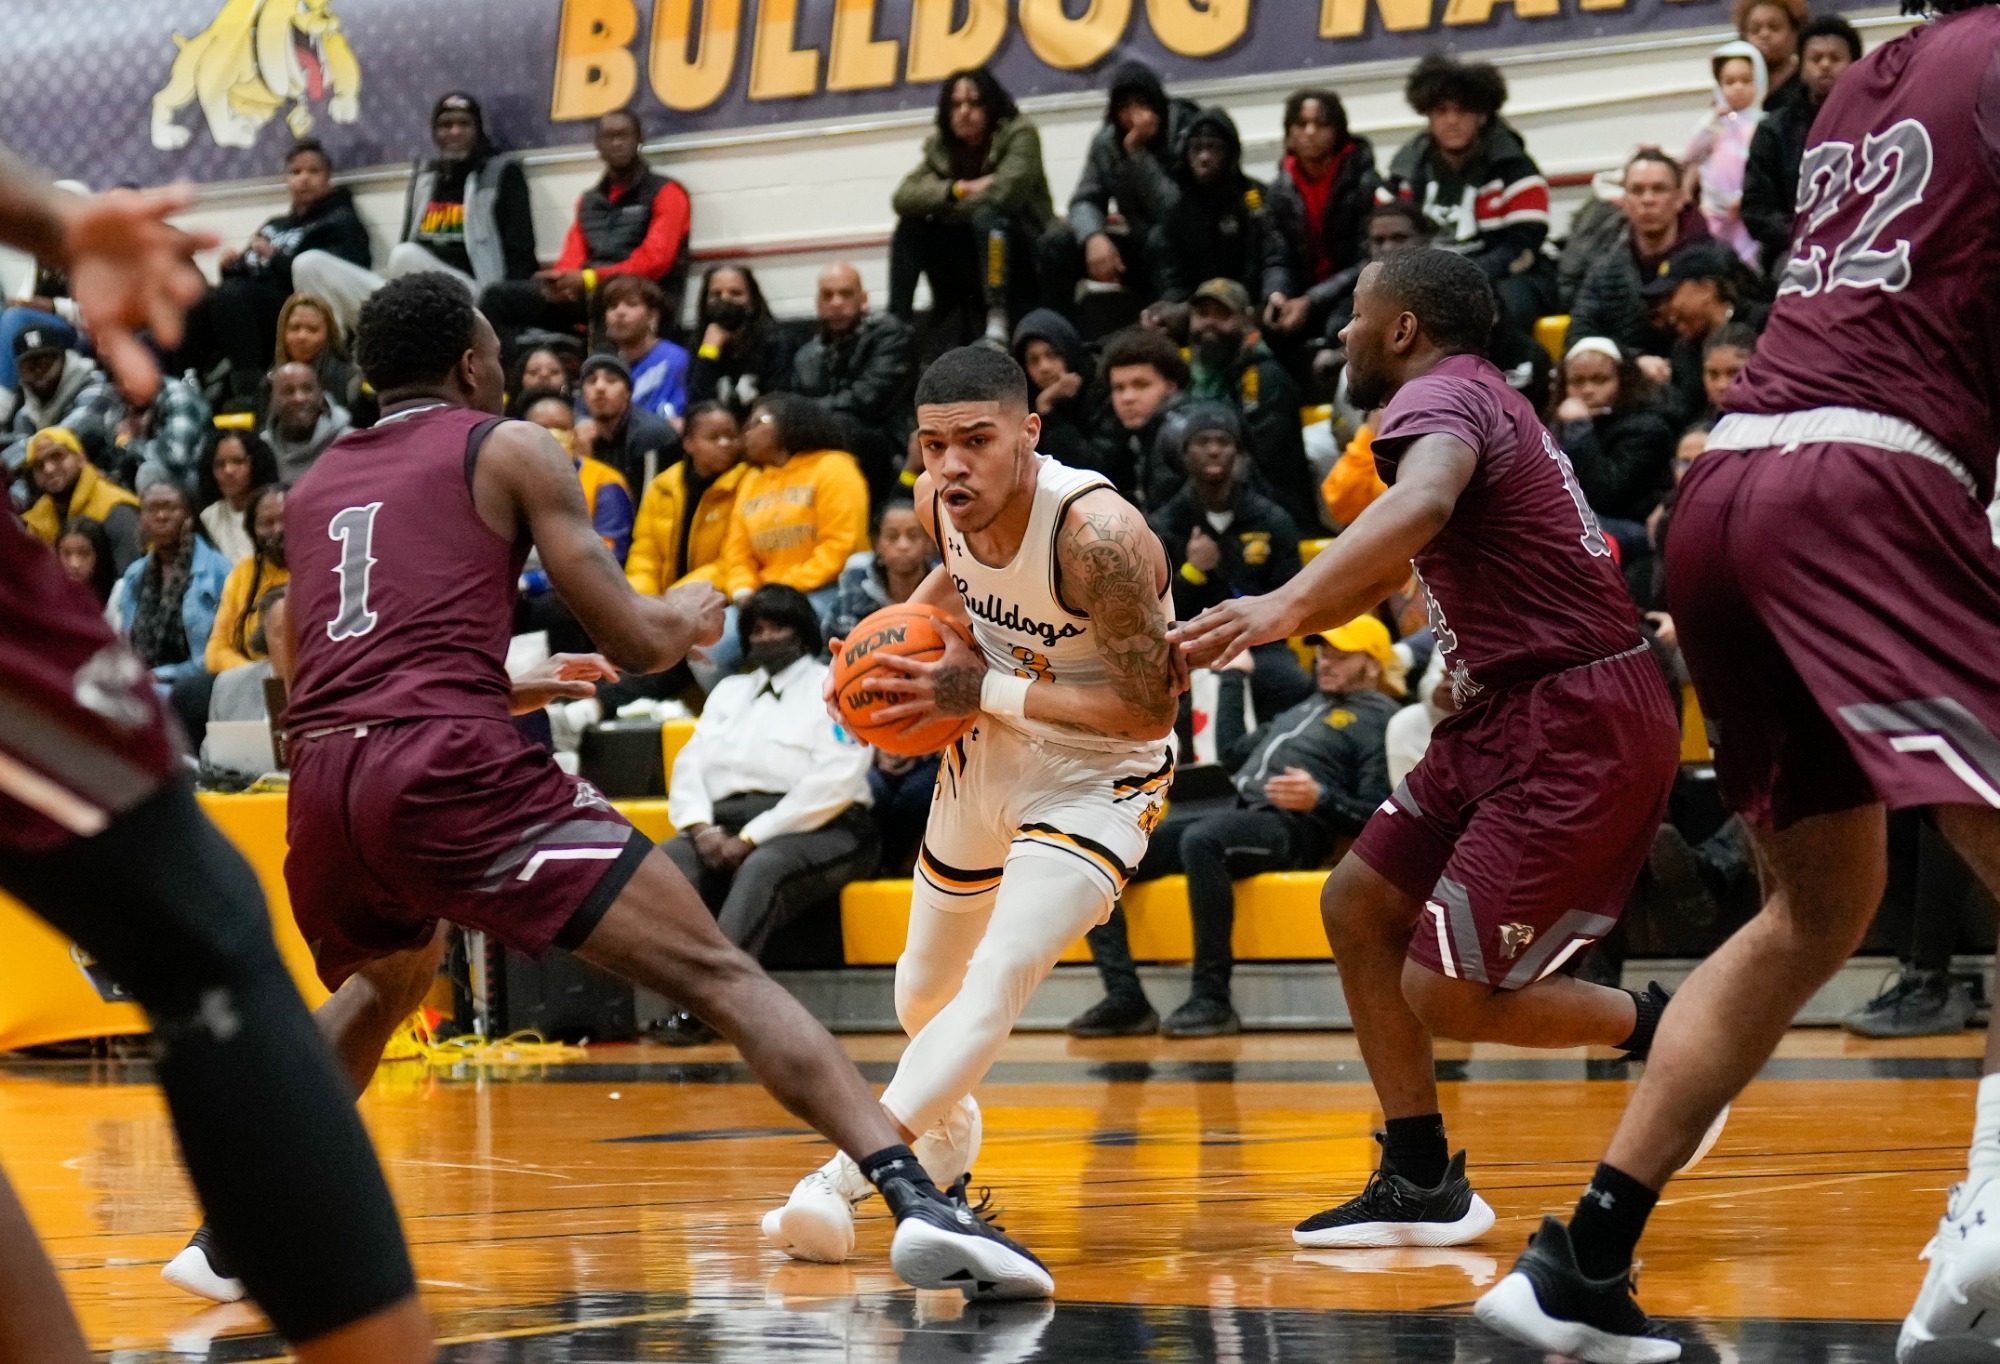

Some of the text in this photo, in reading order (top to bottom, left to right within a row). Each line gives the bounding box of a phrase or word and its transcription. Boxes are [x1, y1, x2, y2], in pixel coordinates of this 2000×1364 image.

[1776, 118, 1933, 297] 22
[326, 501, 384, 642] 1
[844, 624, 908, 668] NCAA
